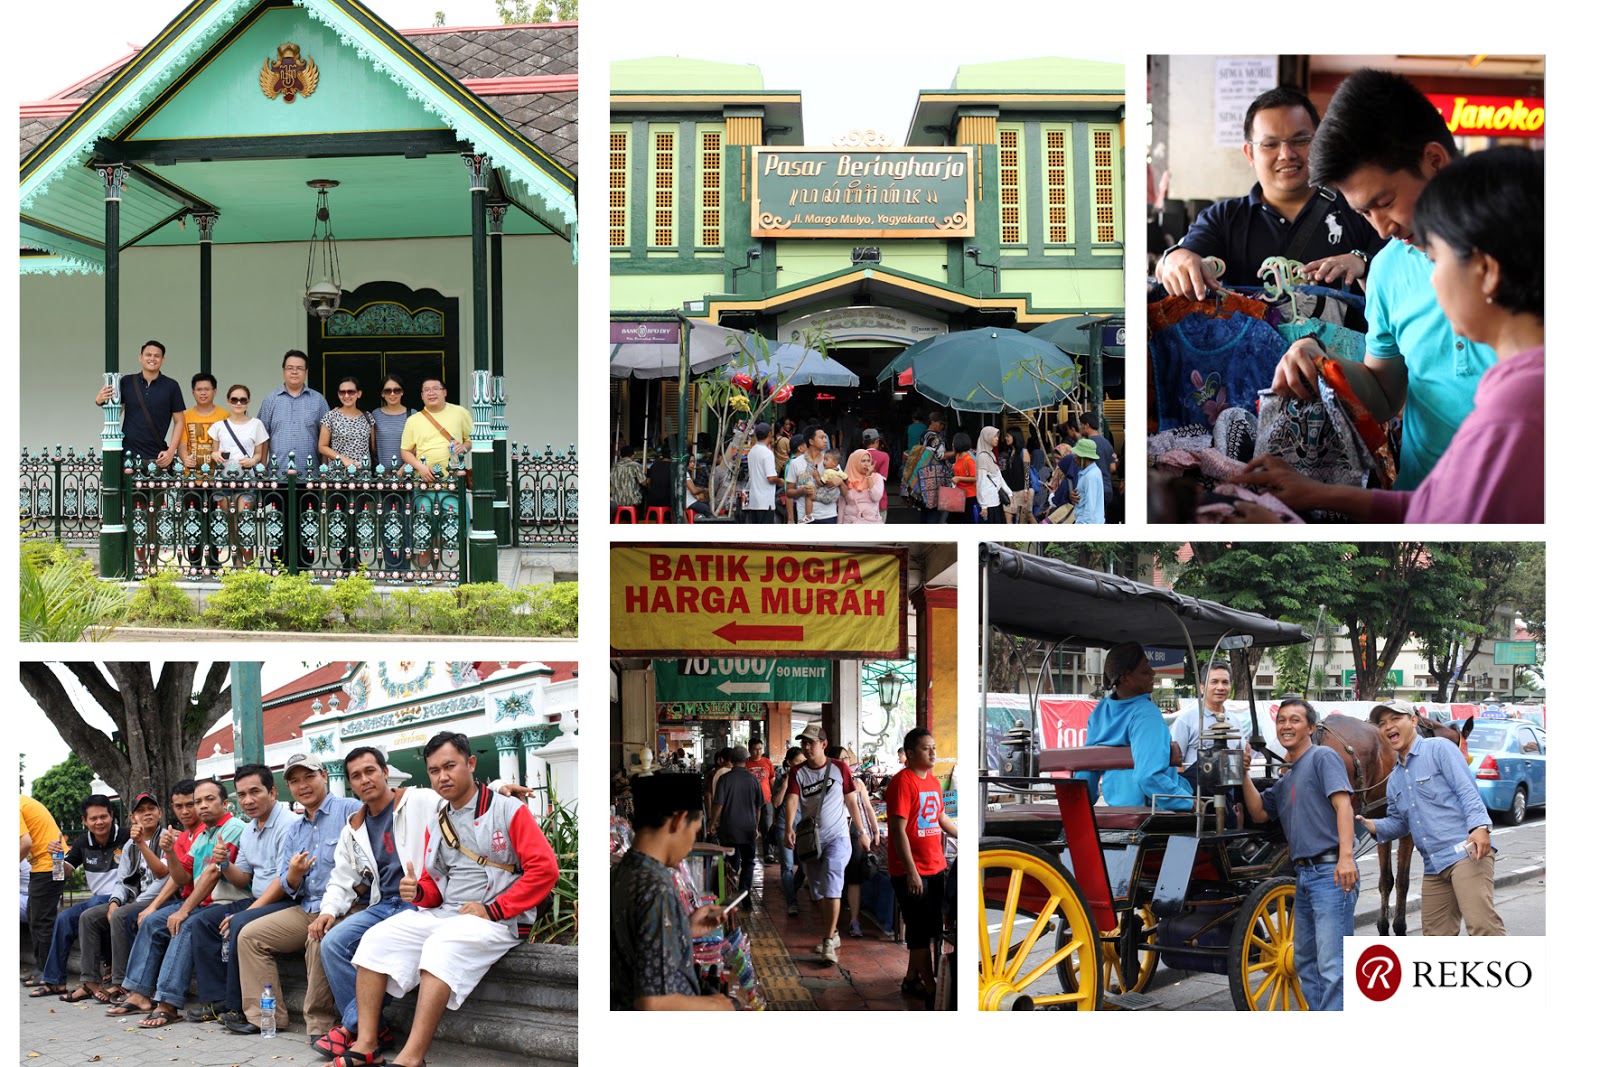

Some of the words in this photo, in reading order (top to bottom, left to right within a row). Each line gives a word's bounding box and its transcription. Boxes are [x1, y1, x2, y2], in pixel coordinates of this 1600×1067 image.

[764, 155, 828, 176] Pasar
[837, 155, 964, 180] Beringharjo
[804, 214, 838, 227] Margo
[839, 214, 875, 227] Mulyo,
[876, 214, 936, 227] Yogyakarta
[650, 554, 751, 582] BATIK
[760, 556, 864, 585] JOGJA
[625, 586, 750, 614] HARGA
[761, 588, 885, 617] MURAH
[792, 667, 826, 678] MENIT
